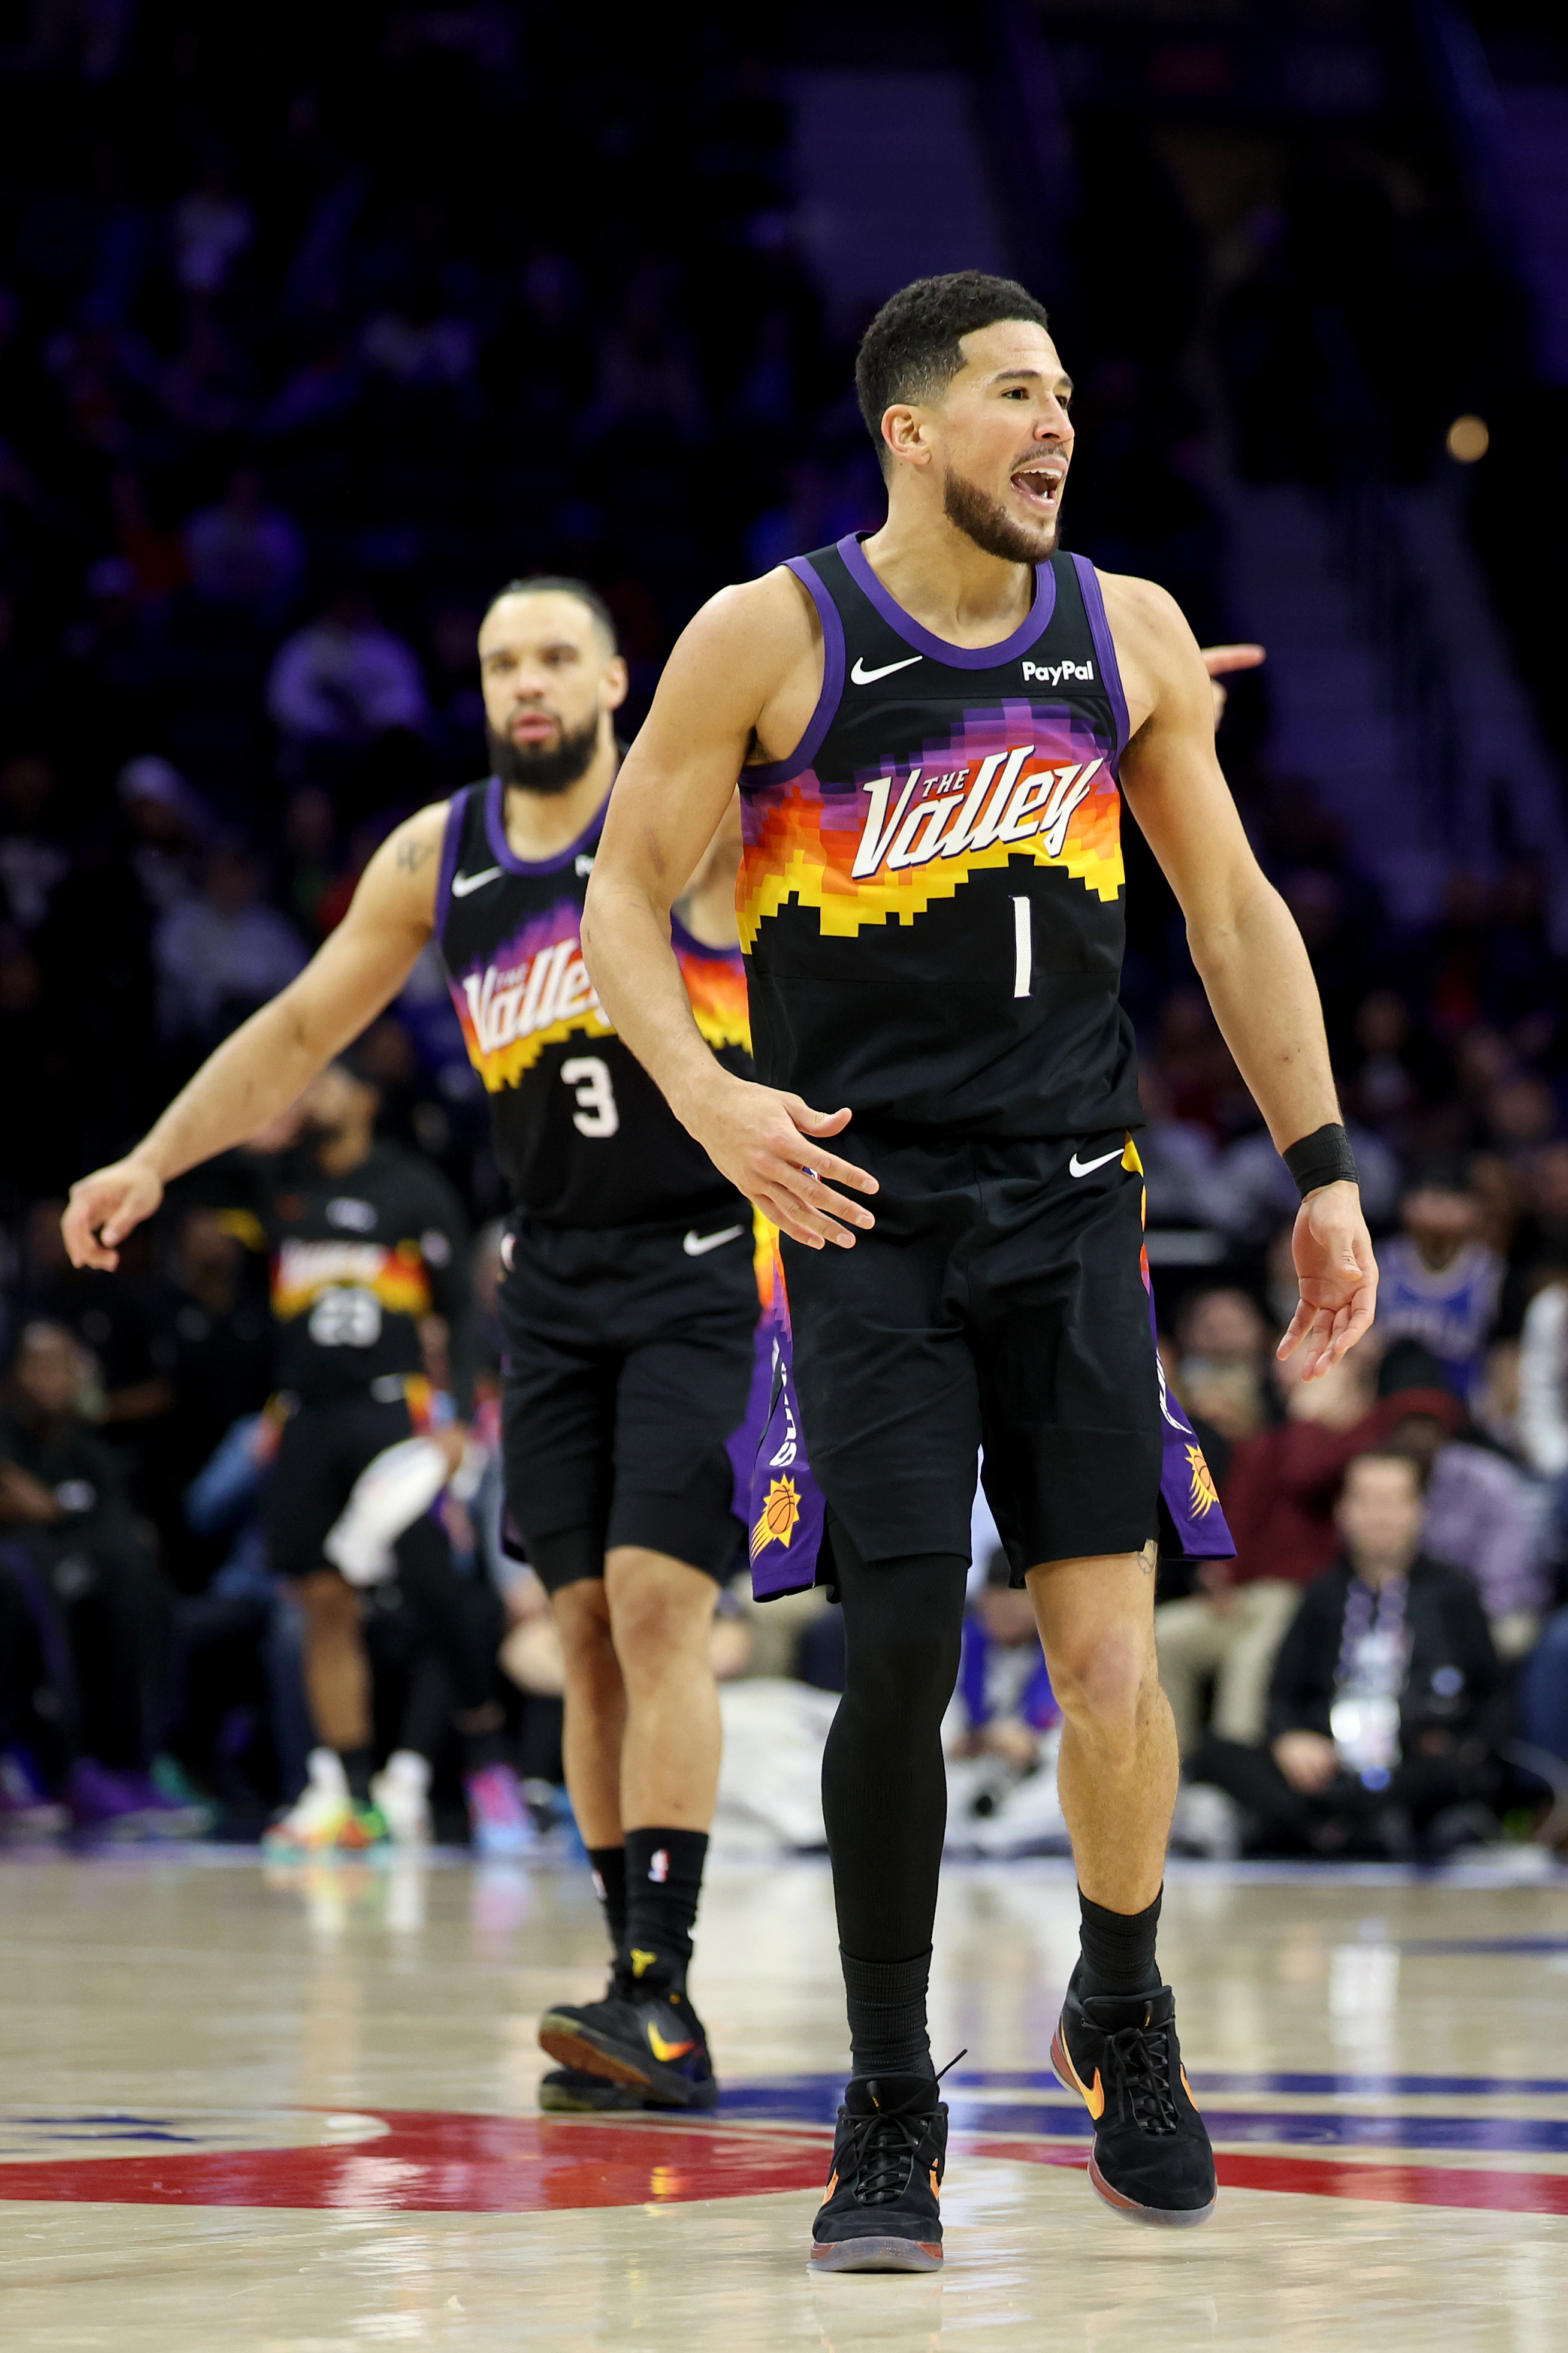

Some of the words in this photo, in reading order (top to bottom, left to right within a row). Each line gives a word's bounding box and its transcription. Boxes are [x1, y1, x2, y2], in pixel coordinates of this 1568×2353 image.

[1022, 661, 1093, 686] PayPal
[851, 745, 1104, 880] Valley
[923, 768, 969, 798] THE
[1010, 895, 1033, 998] 1
[561, 1056, 618, 1138] 3
